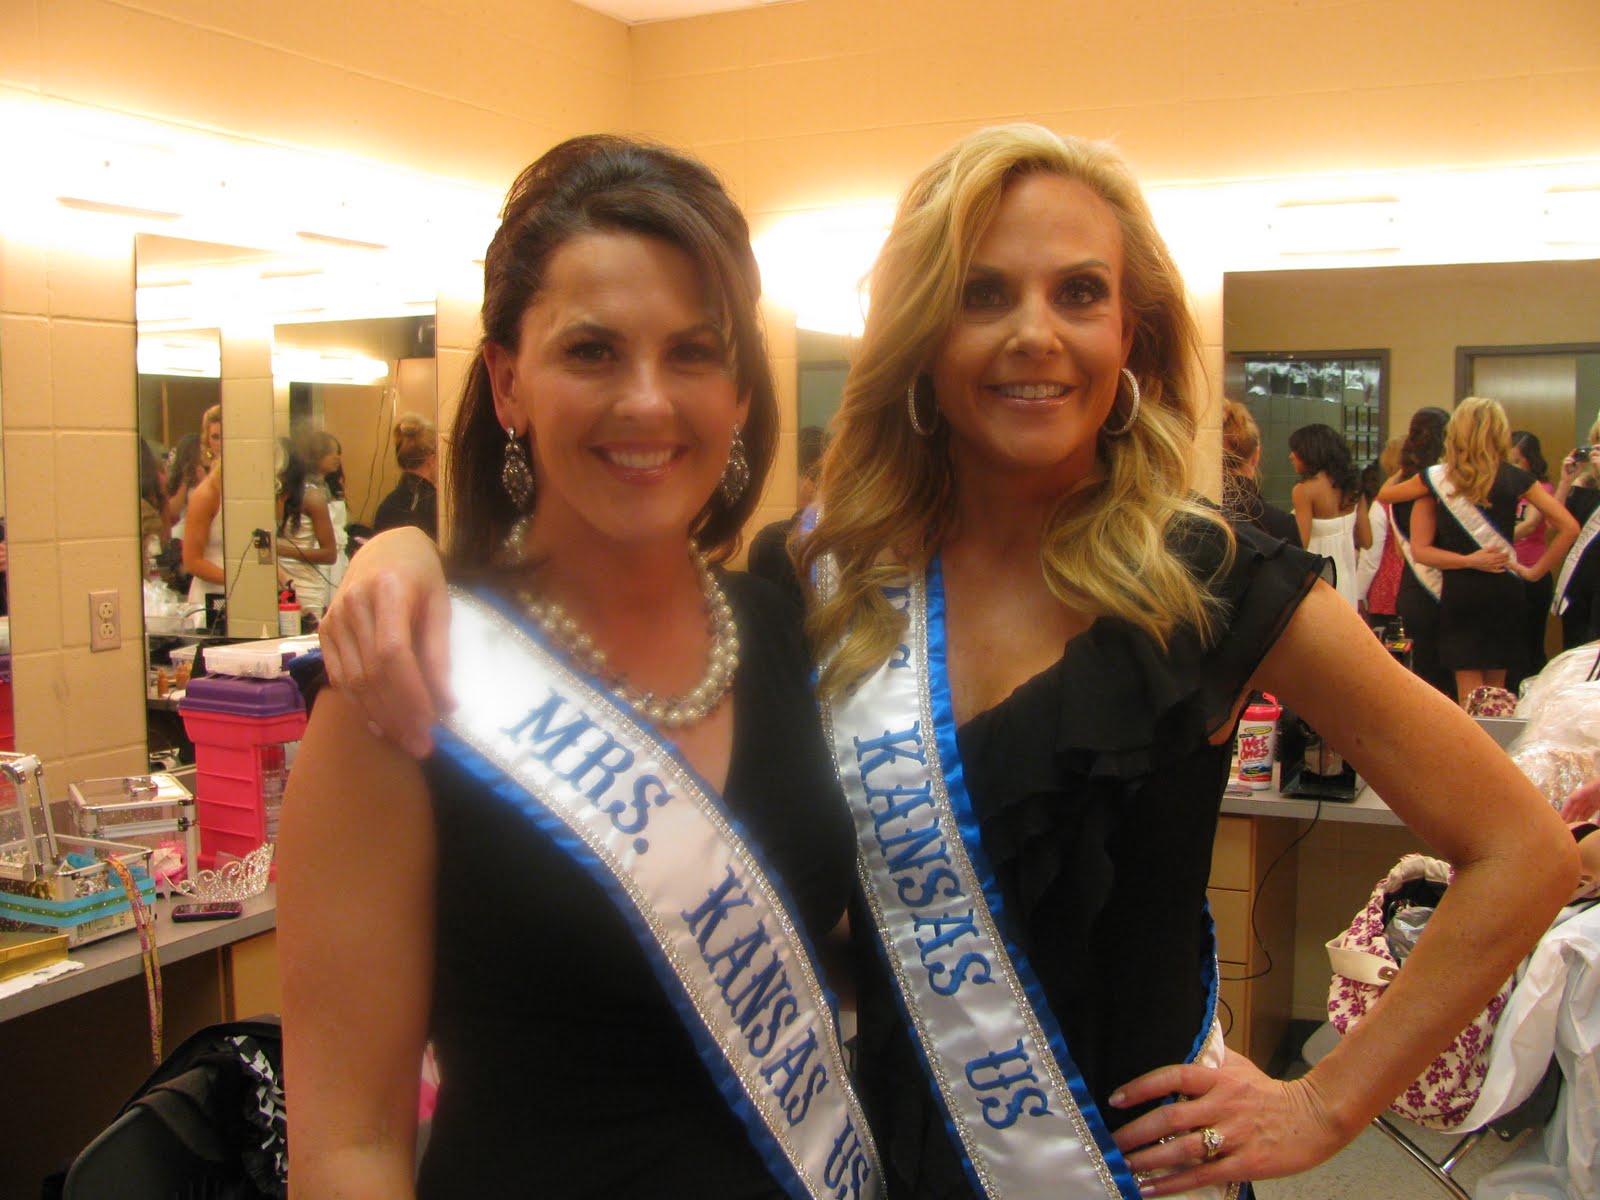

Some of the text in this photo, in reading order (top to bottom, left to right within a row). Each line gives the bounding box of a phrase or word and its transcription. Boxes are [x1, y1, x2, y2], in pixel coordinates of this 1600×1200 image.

[498, 688, 673, 855] MRS.
[681, 864, 829, 1127] KANSAS
[853, 720, 995, 997] KANSAS
[965, 1038, 1055, 1131] US
